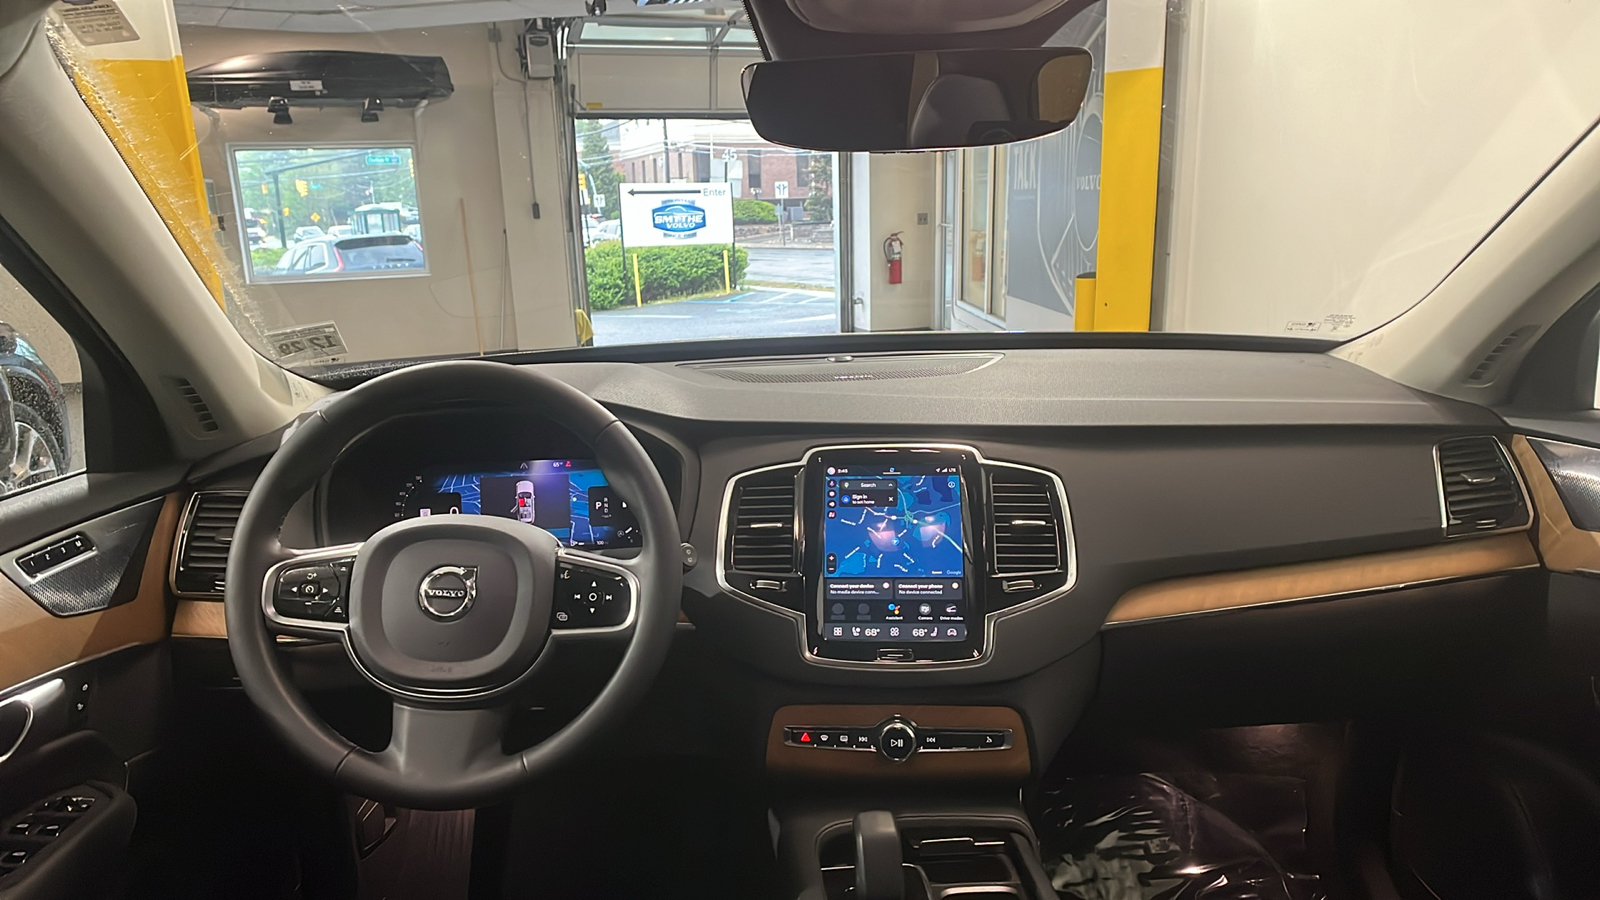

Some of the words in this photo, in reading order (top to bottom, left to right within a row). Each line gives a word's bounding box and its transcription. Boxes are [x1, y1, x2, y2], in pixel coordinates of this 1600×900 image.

[721, 148, 738, 160] 45
[1013, 142, 1037, 190] TACK
[703, 188, 726, 196] Enter
[654, 214, 703, 224] SMYTHE
[595, 501, 603, 510] P
[428, 588, 465, 597] VOLVO
